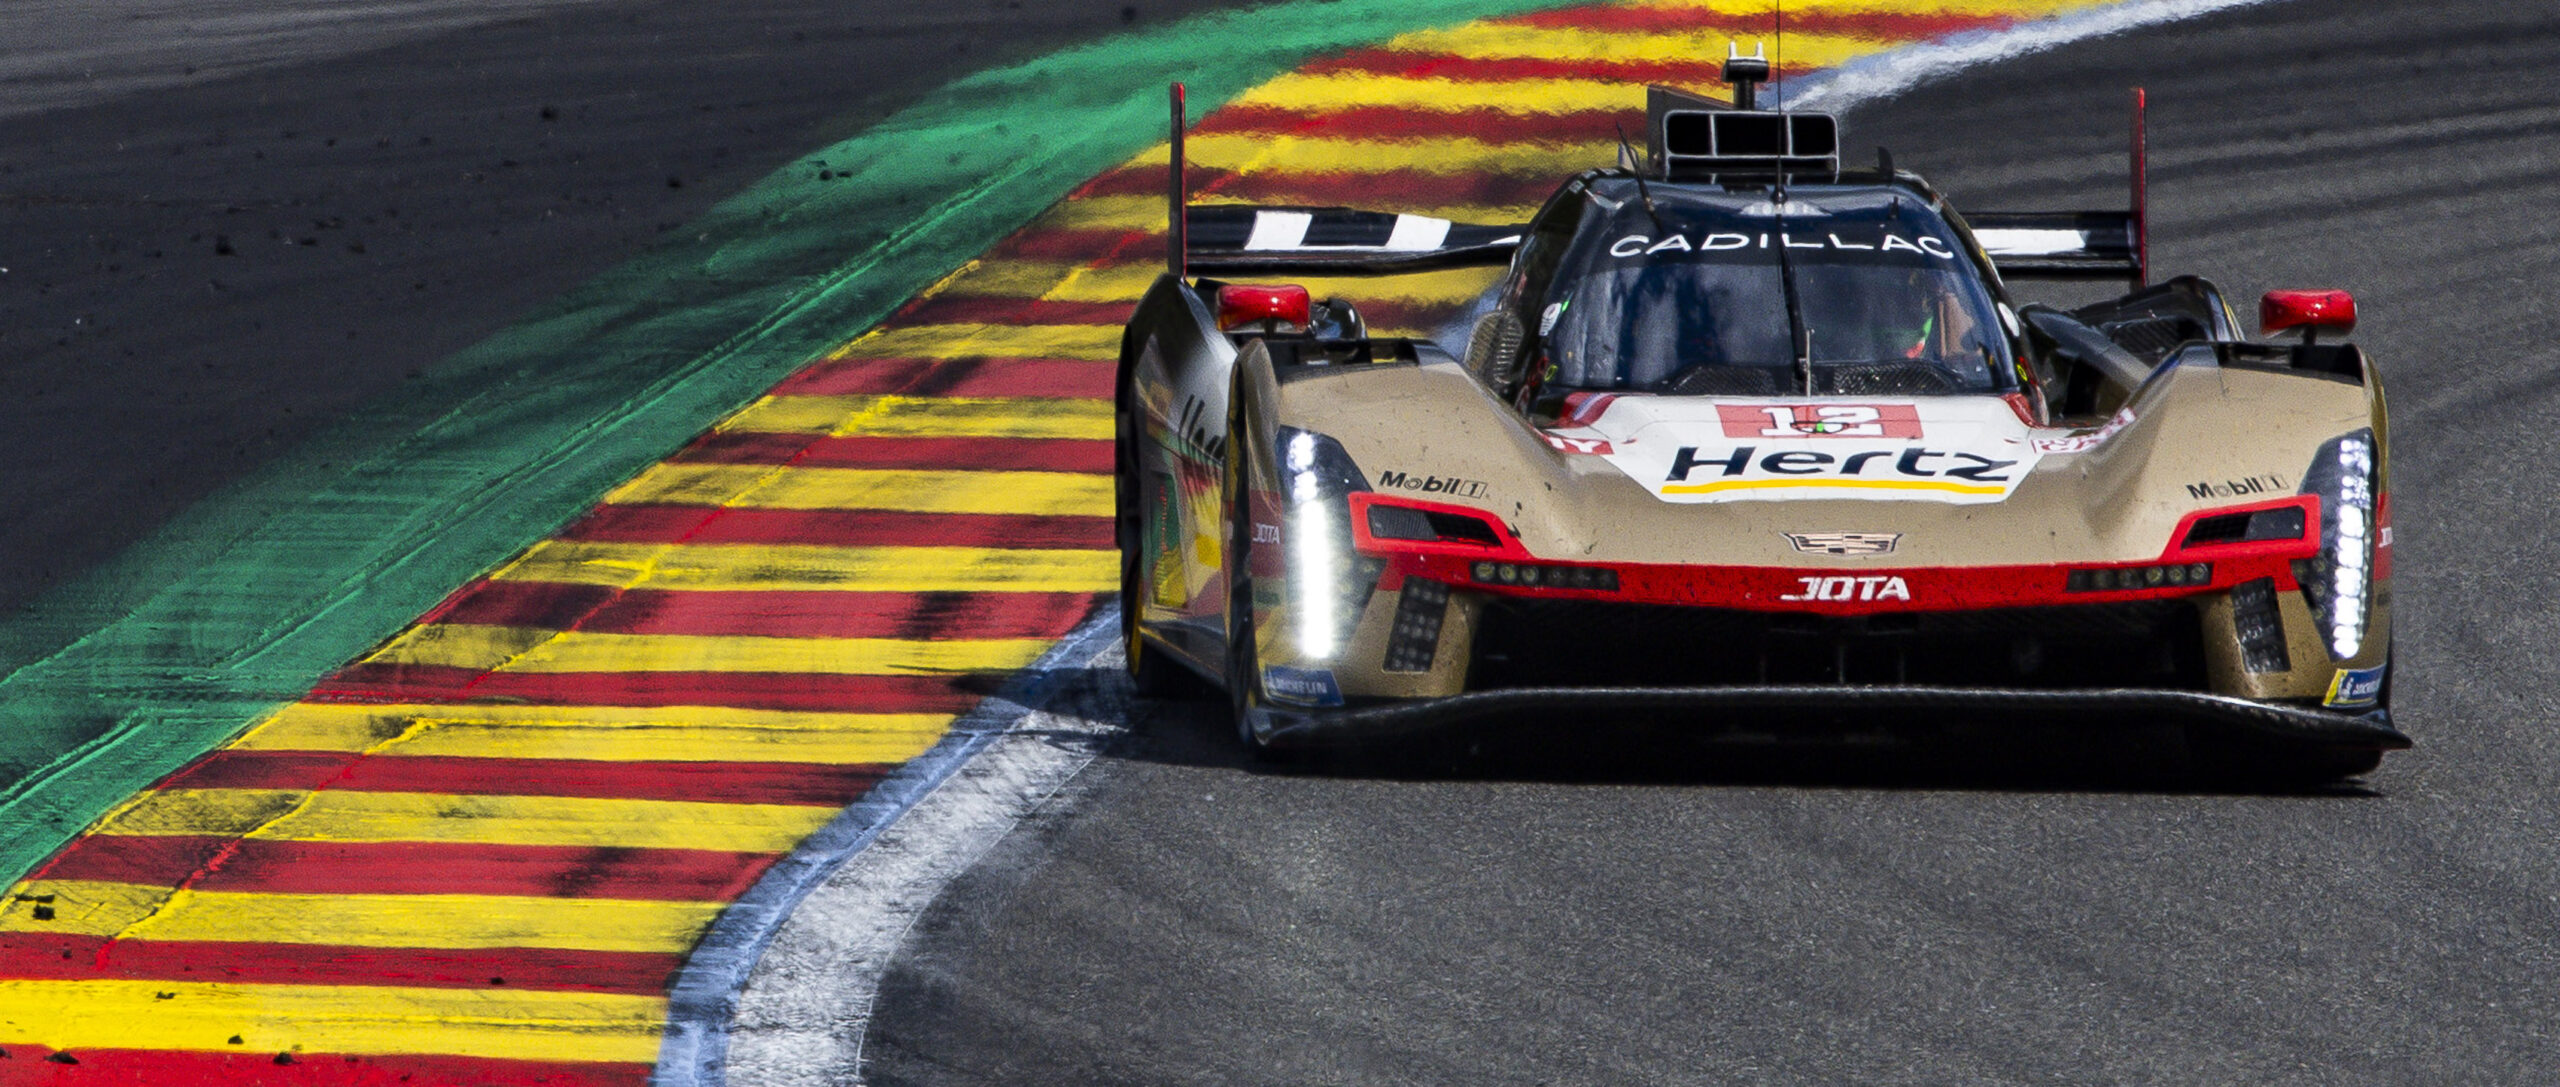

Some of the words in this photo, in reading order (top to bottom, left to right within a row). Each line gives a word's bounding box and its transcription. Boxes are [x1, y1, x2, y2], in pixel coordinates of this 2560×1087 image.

[1610, 233, 1954, 259] CADILLAC
[1759, 405, 1884, 437] 12
[1665, 446, 2018, 482] Hertz
[1379, 470, 1461, 495] Mobil
[1252, 522, 1280, 545] JOTA
[1781, 576, 1911, 601] JOTA
